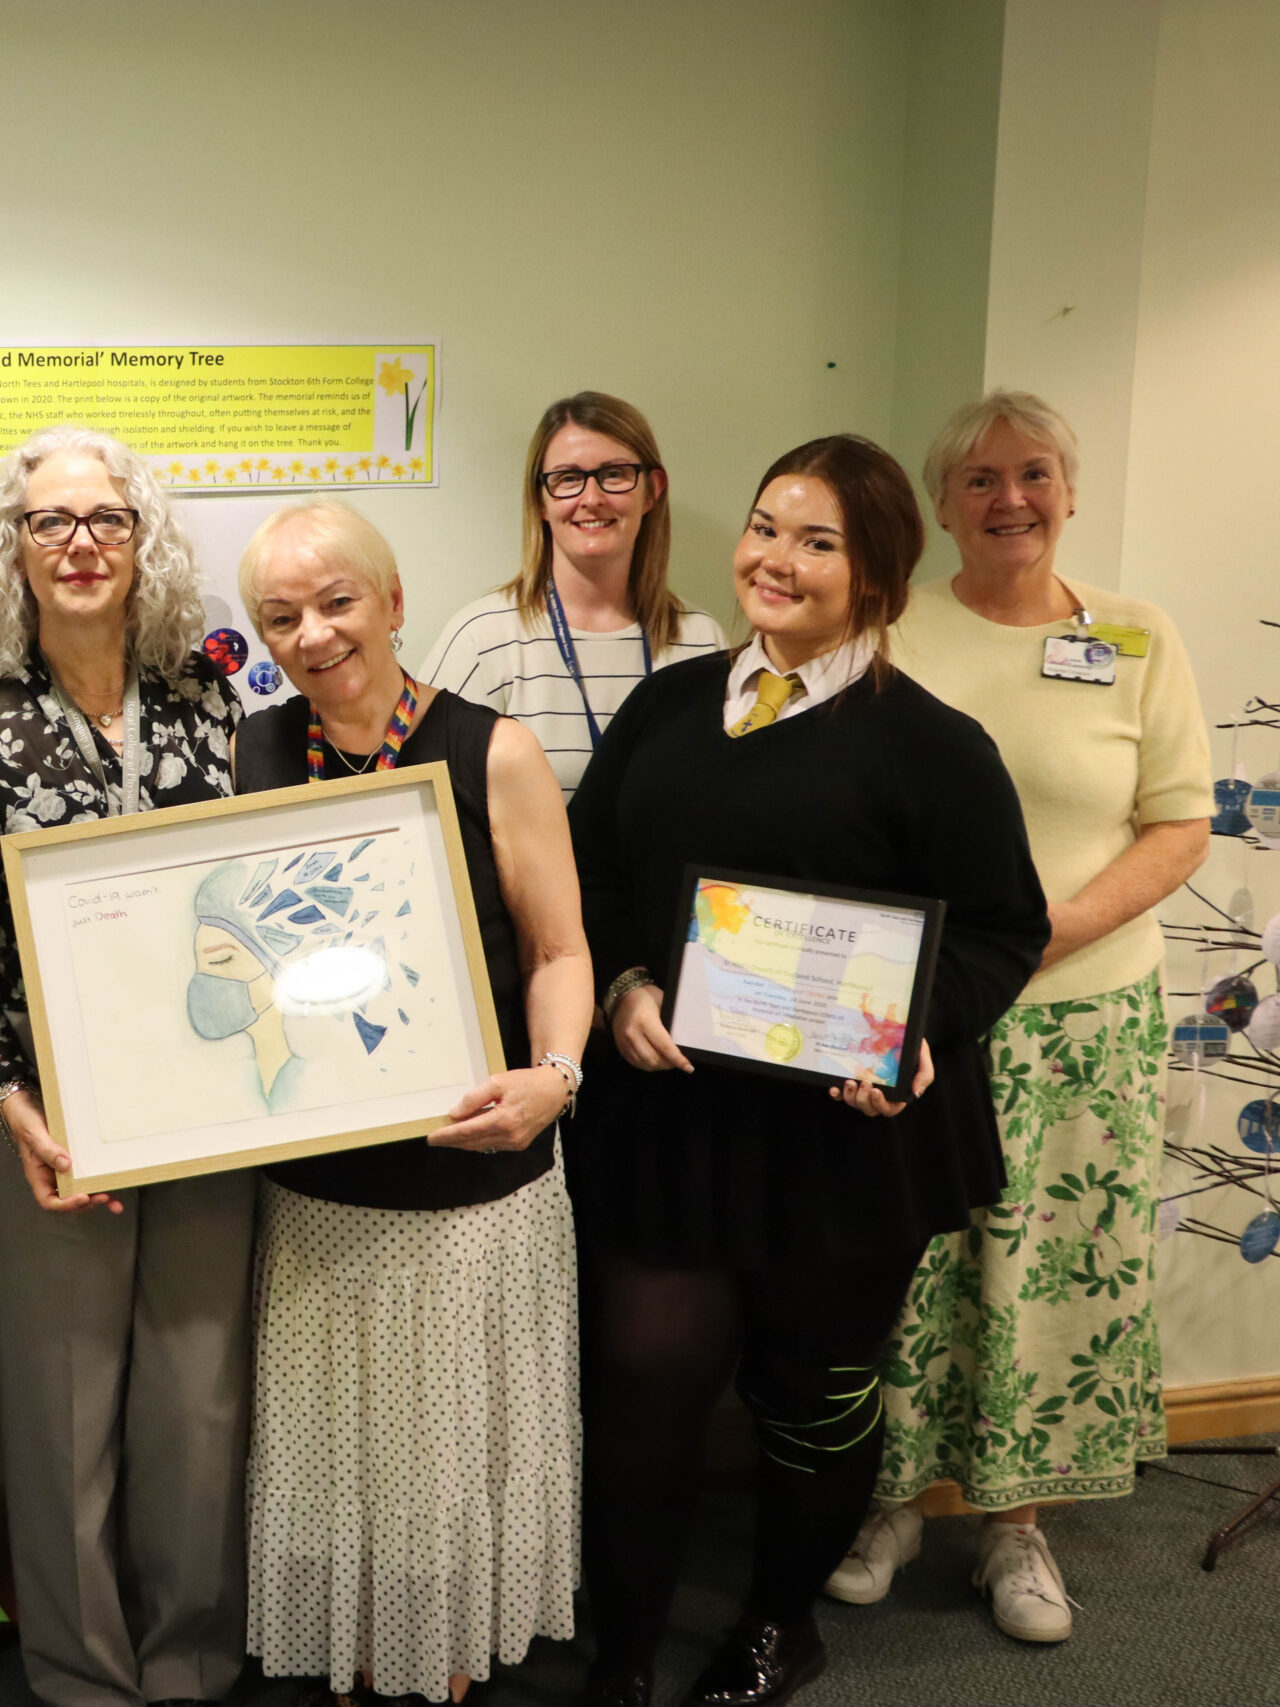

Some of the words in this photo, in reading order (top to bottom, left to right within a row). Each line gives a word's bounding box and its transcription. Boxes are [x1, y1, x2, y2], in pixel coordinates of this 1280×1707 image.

[18, 351, 104, 366] Memorial’
[110, 352, 184, 370] Memory
[188, 351, 224, 366] Tree
[23, 379, 41, 388] Tees
[43, 379, 59, 388] and
[61, 378, 105, 390] Hartlepool
[150, 379, 157, 387] is
[158, 378, 196, 389] designed
[198, 377, 208, 389] by
[210, 377, 245, 386] students
[247, 377, 267, 386] from
[269, 377, 305, 386] Stockton
[306, 376, 321, 385] 6th
[323, 376, 344, 385] Form
[345, 376, 374, 387] College
[21, 396, 29, 404] in
[57, 395, 73, 404] The
[74, 396, 94, 406] print
[96, 394, 122, 403] below
[125, 395, 131, 403] is
[140, 396, 160, 405] copy
[163, 394, 172, 402] of
[173, 394, 187, 402] the
[189, 393, 220, 405] original
[259, 393, 273, 401] The
[275, 392, 314, 401] memorial
[316, 392, 349, 401] reminds
[362, 392, 371, 400] of
[9, 411, 23, 420] the
[25, 410, 43, 419] NHS
[45, 410, 64, 419] staff
[66, 410, 84, 419] who
[86, 410, 117, 419] worked
[118, 409, 156, 421] tirelessly
[209, 408, 230, 417] often
[232, 409, 262, 419] putting
[264, 407, 310, 417] themselves
[312, 408, 320, 416] at
[341, 407, 356, 416] and
[358, 407, 371, 415] the
[122, 425, 157, 434] isolation
[160, 424, 176, 433] and
[219, 424, 225, 432] If
[227, 426, 242, 435] you
[244, 423, 263, 432] wish
[264, 424, 273, 432] to
[275, 423, 296, 432] leave
[306, 424, 340, 434] message
[342, 422, 352, 431] of
[140, 440, 149, 449] of
[150, 440, 164, 449] the
[166, 439, 199, 448] artwork
[201, 439, 217, 448] and
[218, 439, 238, 450] hang
[240, 439, 246, 447] it
[261, 438, 274, 447] the
[298, 437, 321, 446] Thank
[125, 700, 136, 725] Royal
[125, 727, 137, 760] College
[127, 761, 137, 771] of
[125, 773, 137, 814] Physician
[68, 891, 120, 909] Covid-19
[95, 909, 128, 922] Death
[752, 915, 857, 943] CERTIFICATE
